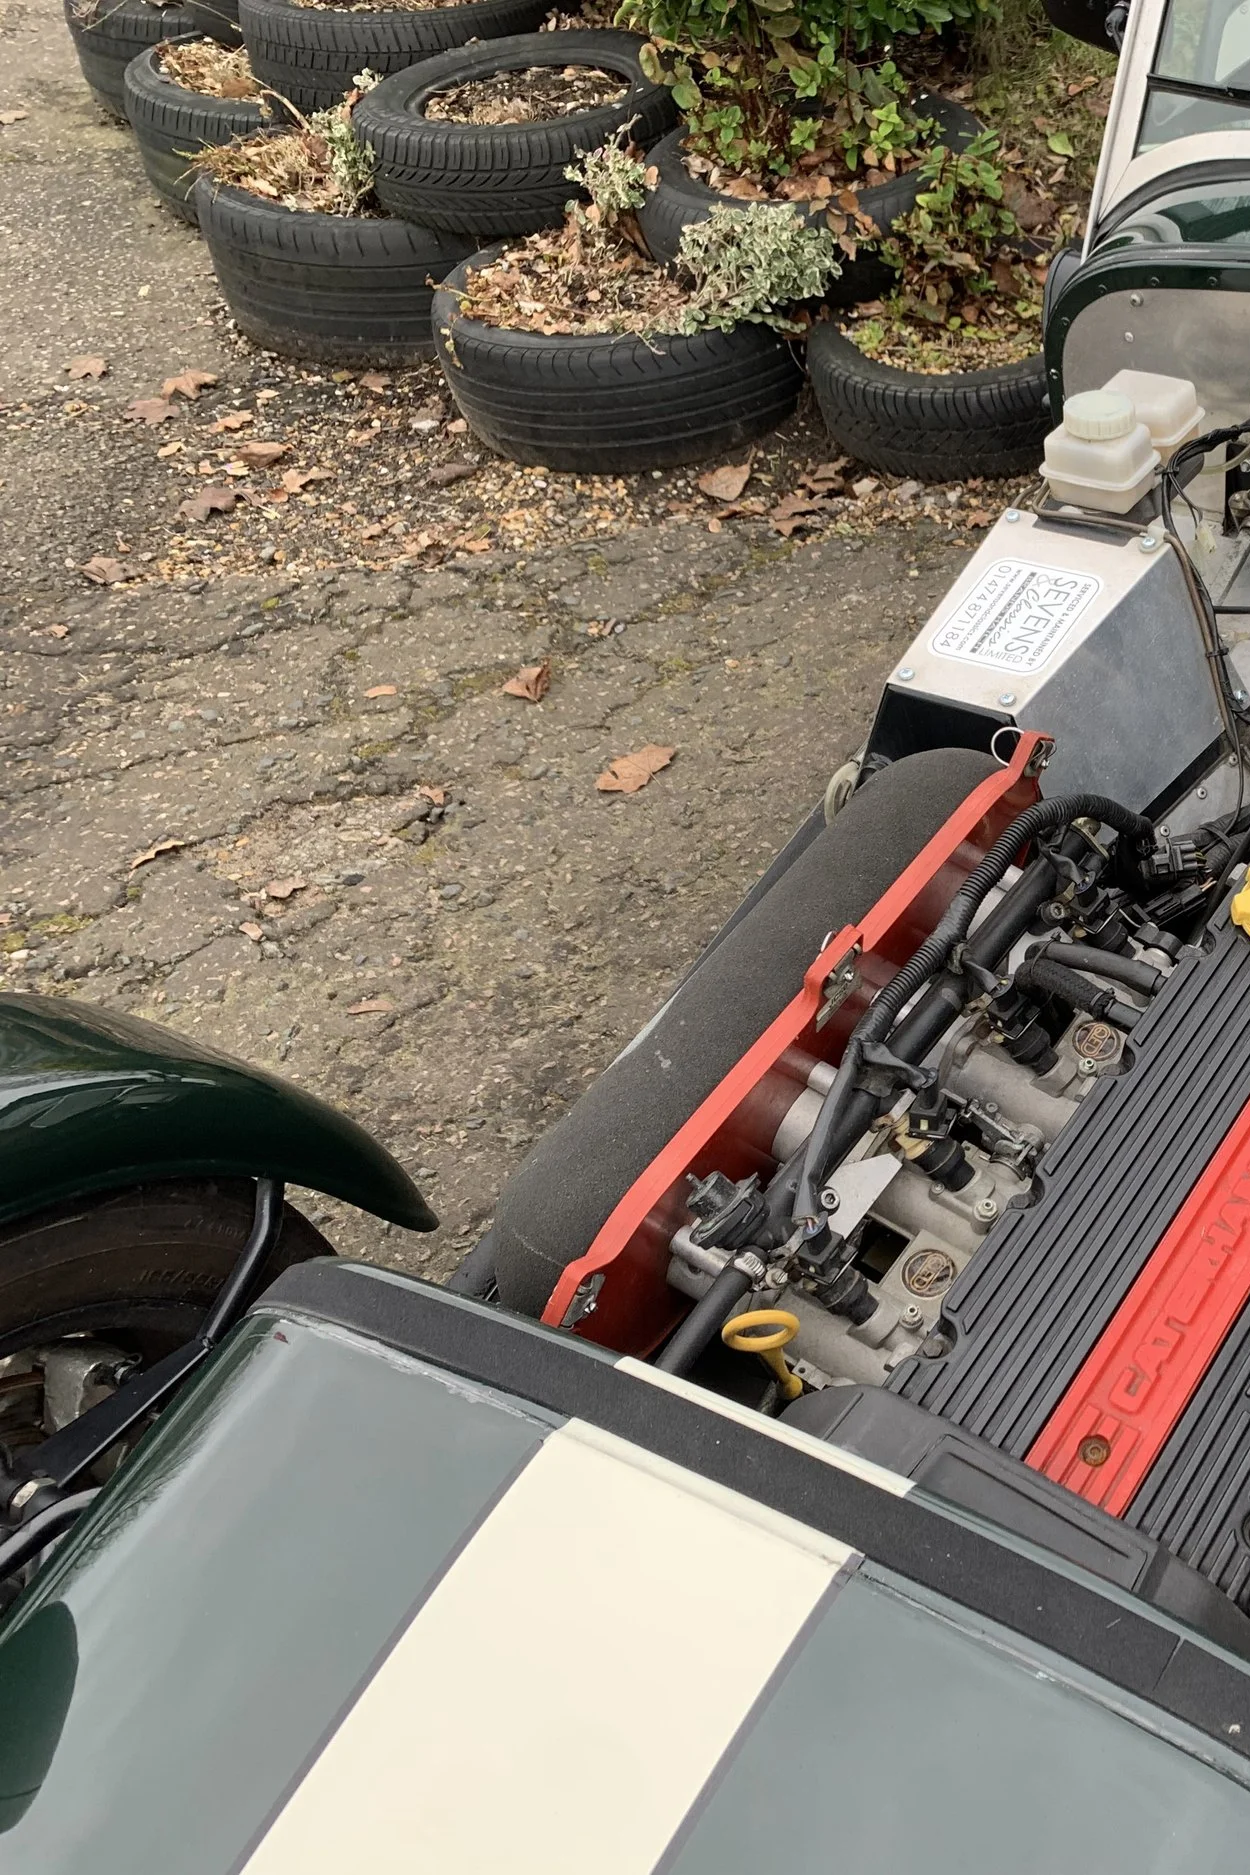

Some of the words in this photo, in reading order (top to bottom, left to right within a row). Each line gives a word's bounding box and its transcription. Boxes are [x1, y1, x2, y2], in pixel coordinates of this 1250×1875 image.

[976, 565, 1012, 601] 01474
[1066, 583, 1092, 612] SERVICED
[939, 603, 982, 648] 871184
[989, 588, 1040, 647] Classics
[1004, 577, 1078, 655] SEVENS
[978, 647, 1023, 663] LIMITED
[1033, 617, 1064, 657] MAINTAINED
